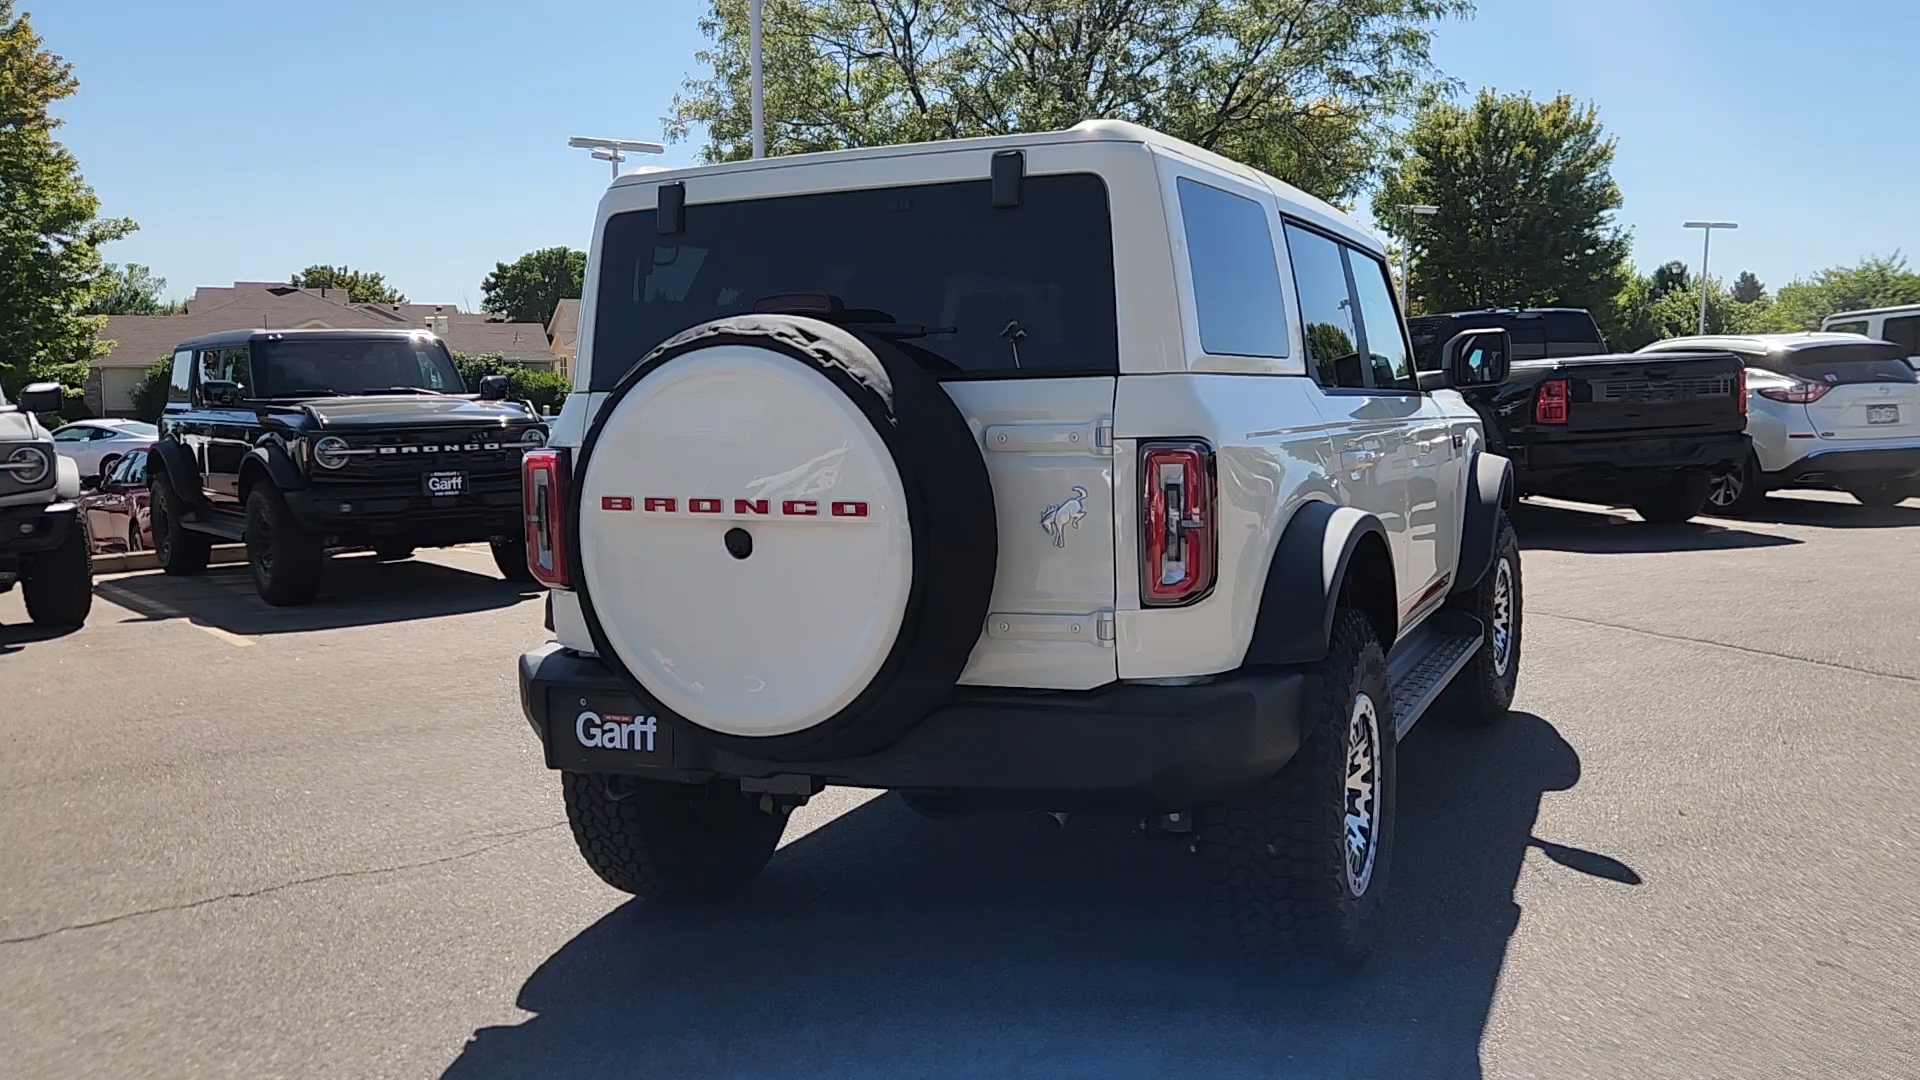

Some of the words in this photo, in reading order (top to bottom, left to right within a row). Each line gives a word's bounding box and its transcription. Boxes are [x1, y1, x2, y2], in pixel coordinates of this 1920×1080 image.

[379, 442, 500, 454] BRONCO
[428, 476, 462, 491] Garff
[600, 495, 869, 518] BRONCO
[576, 711, 657, 751] Garff
